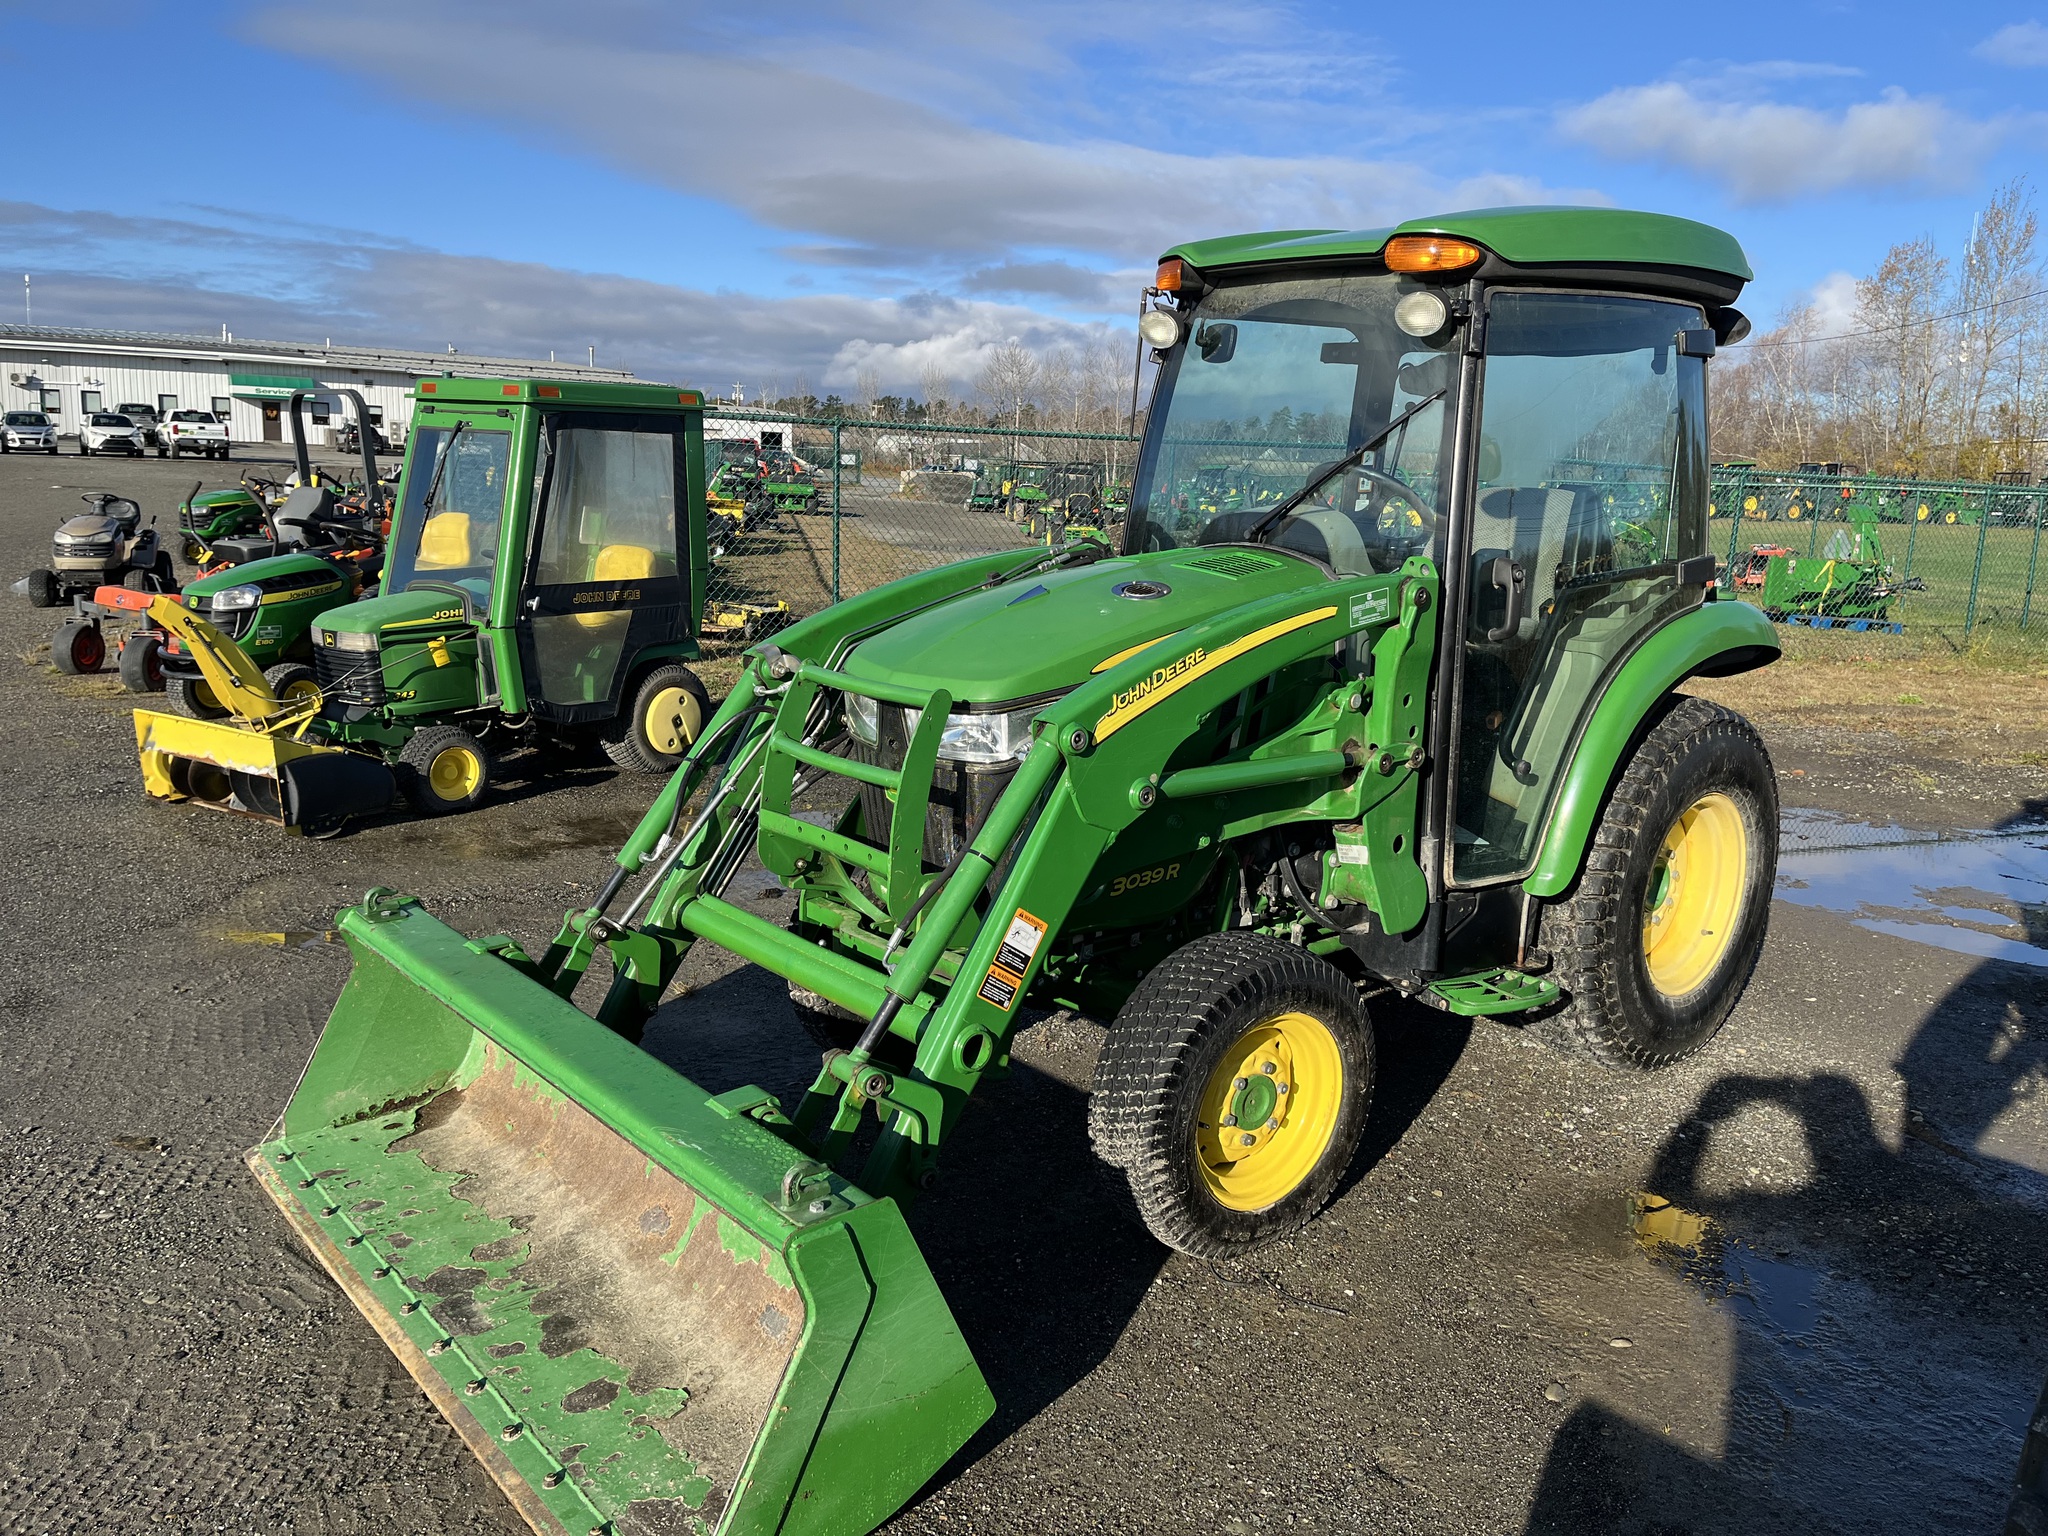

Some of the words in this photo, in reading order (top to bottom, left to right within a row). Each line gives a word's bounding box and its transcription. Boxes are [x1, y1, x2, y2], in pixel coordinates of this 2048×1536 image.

[288, 591, 309, 600] JOHN
[310, 585, 334, 596] DEERE
[573, 591, 604, 604] JOHN
[606, 589, 640, 601] DEERE
[1107, 677, 1153, 717] JOHN
[1152, 647, 1207, 691] DEERE
[392, 690, 416, 701] 345
[1023, 914, 1044, 930] WARNING
[996, 971, 1018, 986] WARNING
